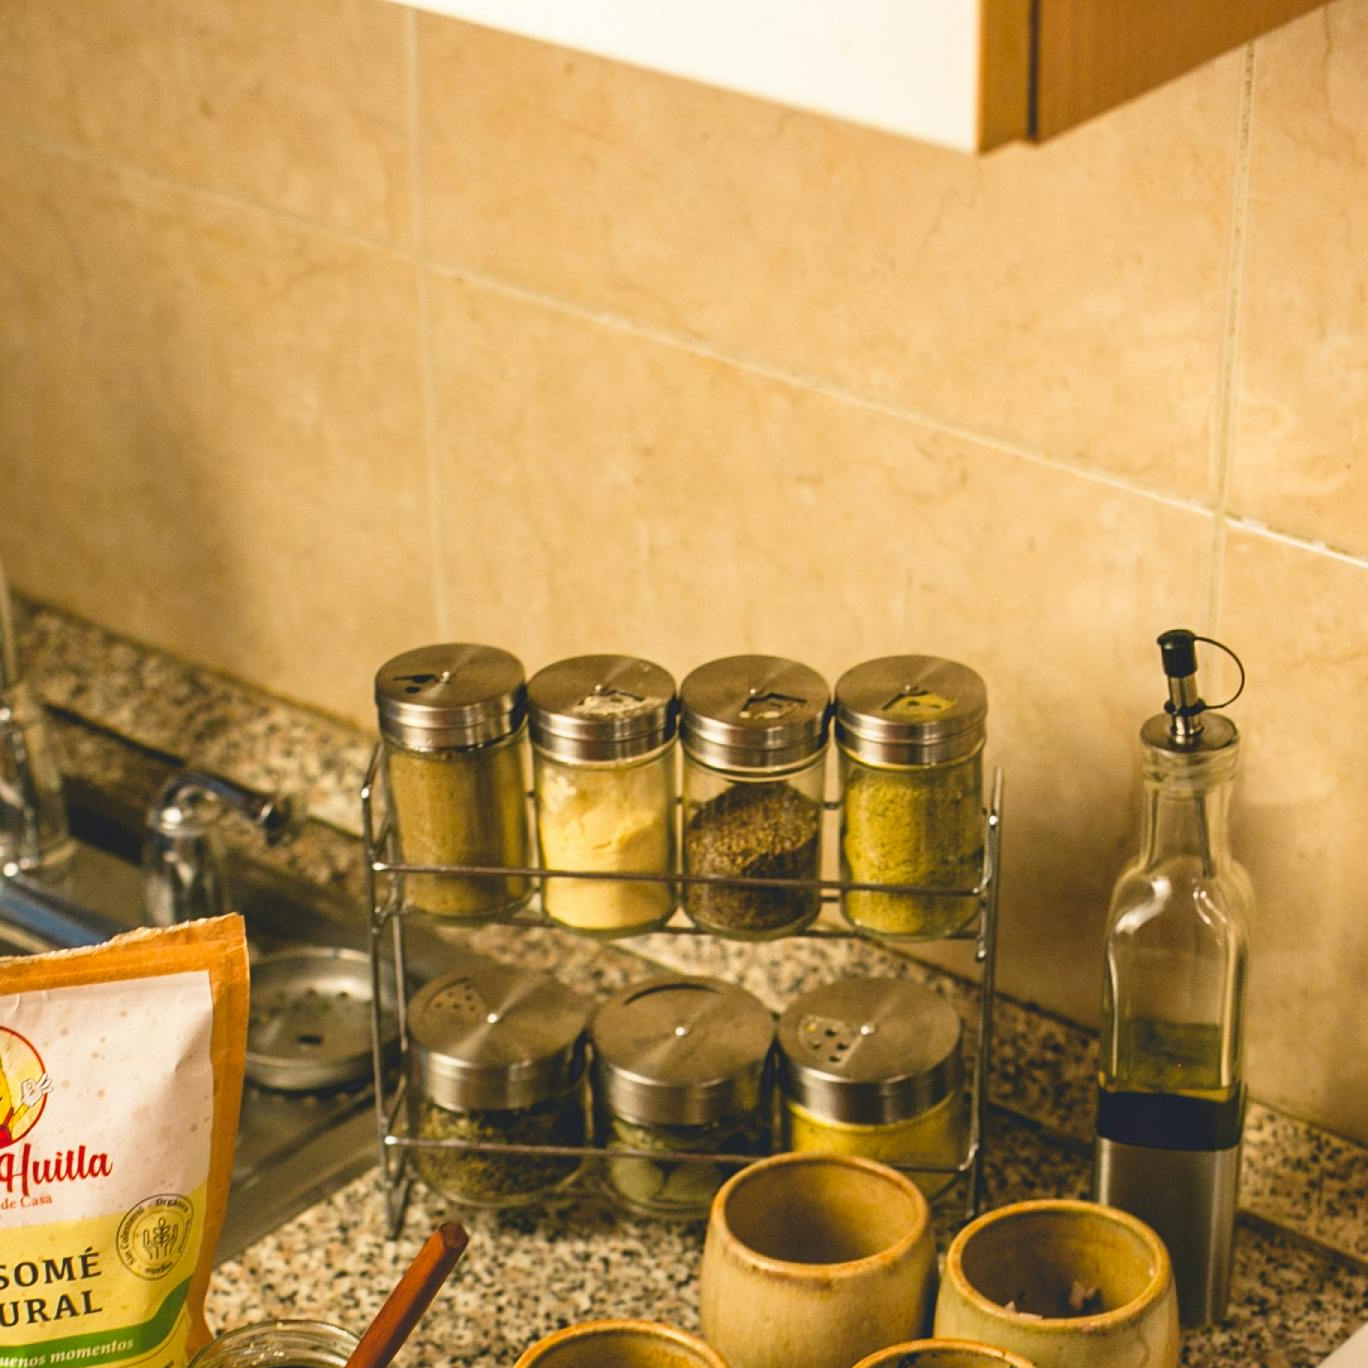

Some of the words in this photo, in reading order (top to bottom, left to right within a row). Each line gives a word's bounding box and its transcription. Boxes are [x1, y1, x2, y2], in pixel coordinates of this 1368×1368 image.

[1, 1198, 16, 1210] de
[20, 1194, 52, 1209] Casa
[50, 1338, 134, 1363] momentos
